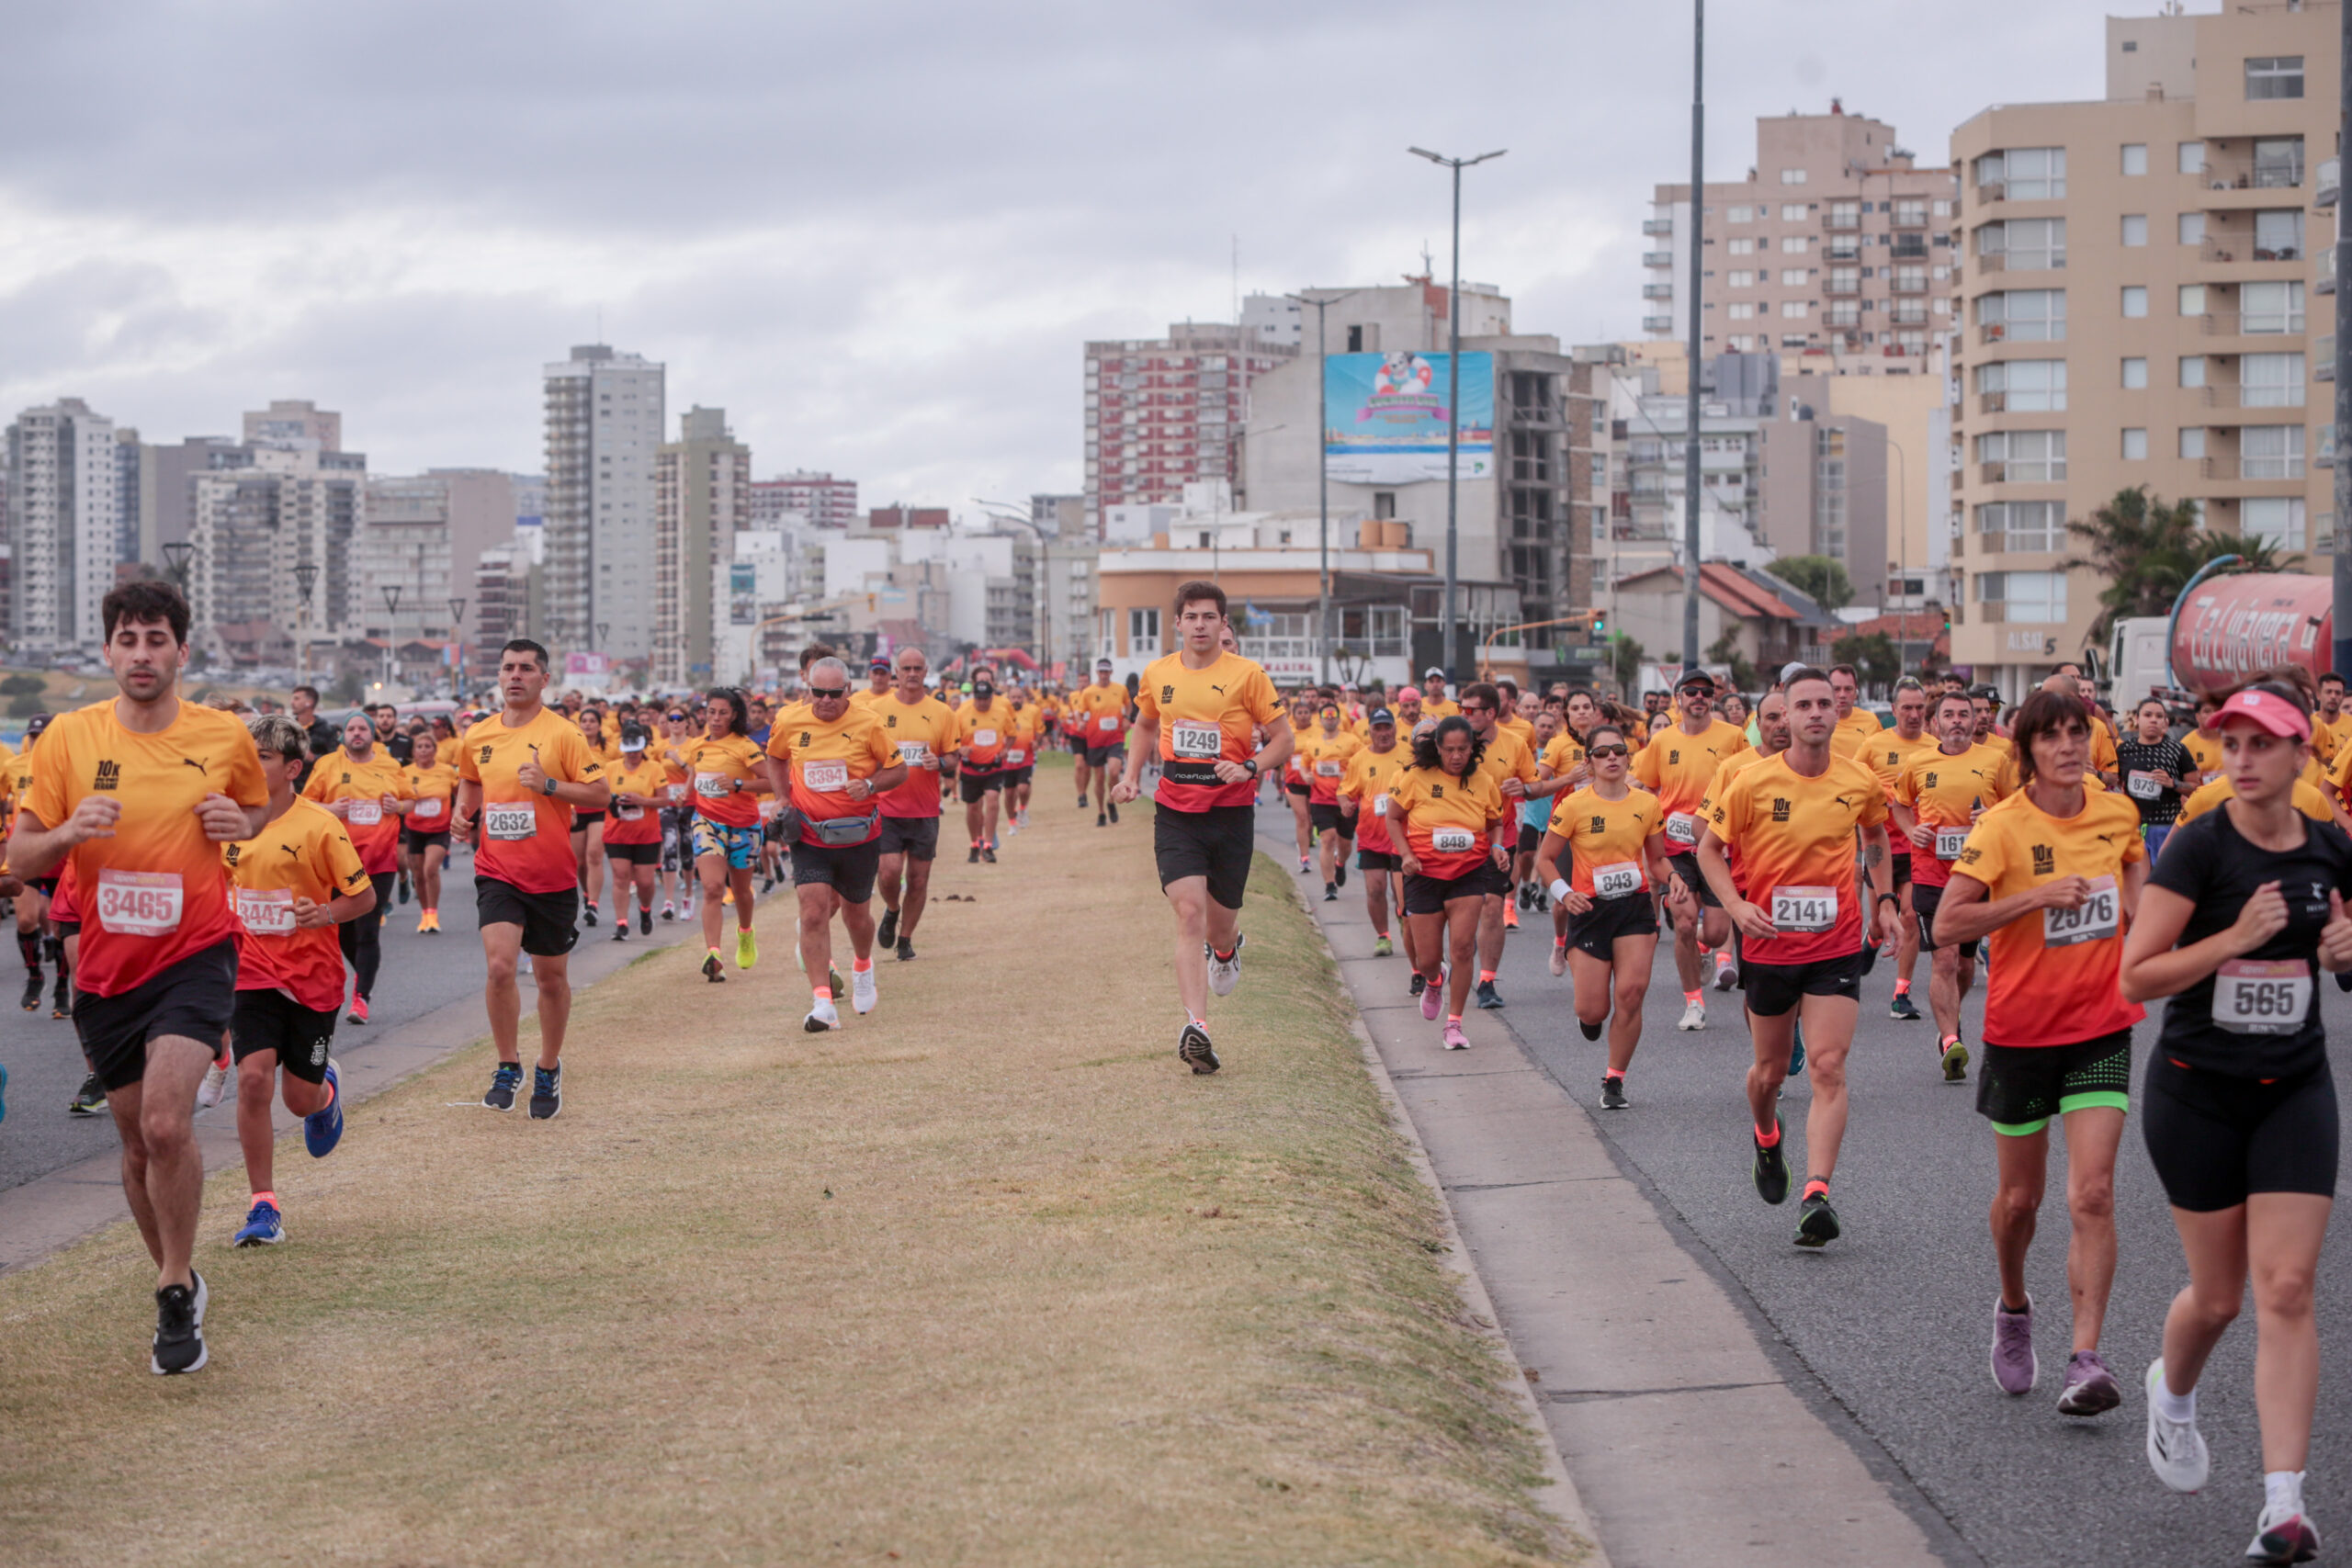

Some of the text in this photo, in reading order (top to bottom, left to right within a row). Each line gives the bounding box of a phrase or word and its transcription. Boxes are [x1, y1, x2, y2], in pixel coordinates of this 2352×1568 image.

[1179, 730, 1217, 750] 1249
[808, 768, 842, 785] 3394
[2133, 779, 2154, 793] 873
[490, 813, 530, 831] 2632
[1668, 819, 1690, 836] 255
[1441, 836, 1466, 848] 848
[1940, 836, 1964, 852] 161
[1602, 872, 1633, 892] 843
[103, 887, 174, 921] 3465
[1778, 899, 1827, 921] 2141
[239, 902, 285, 926] 3447
[2234, 982, 2295, 1015] 565
